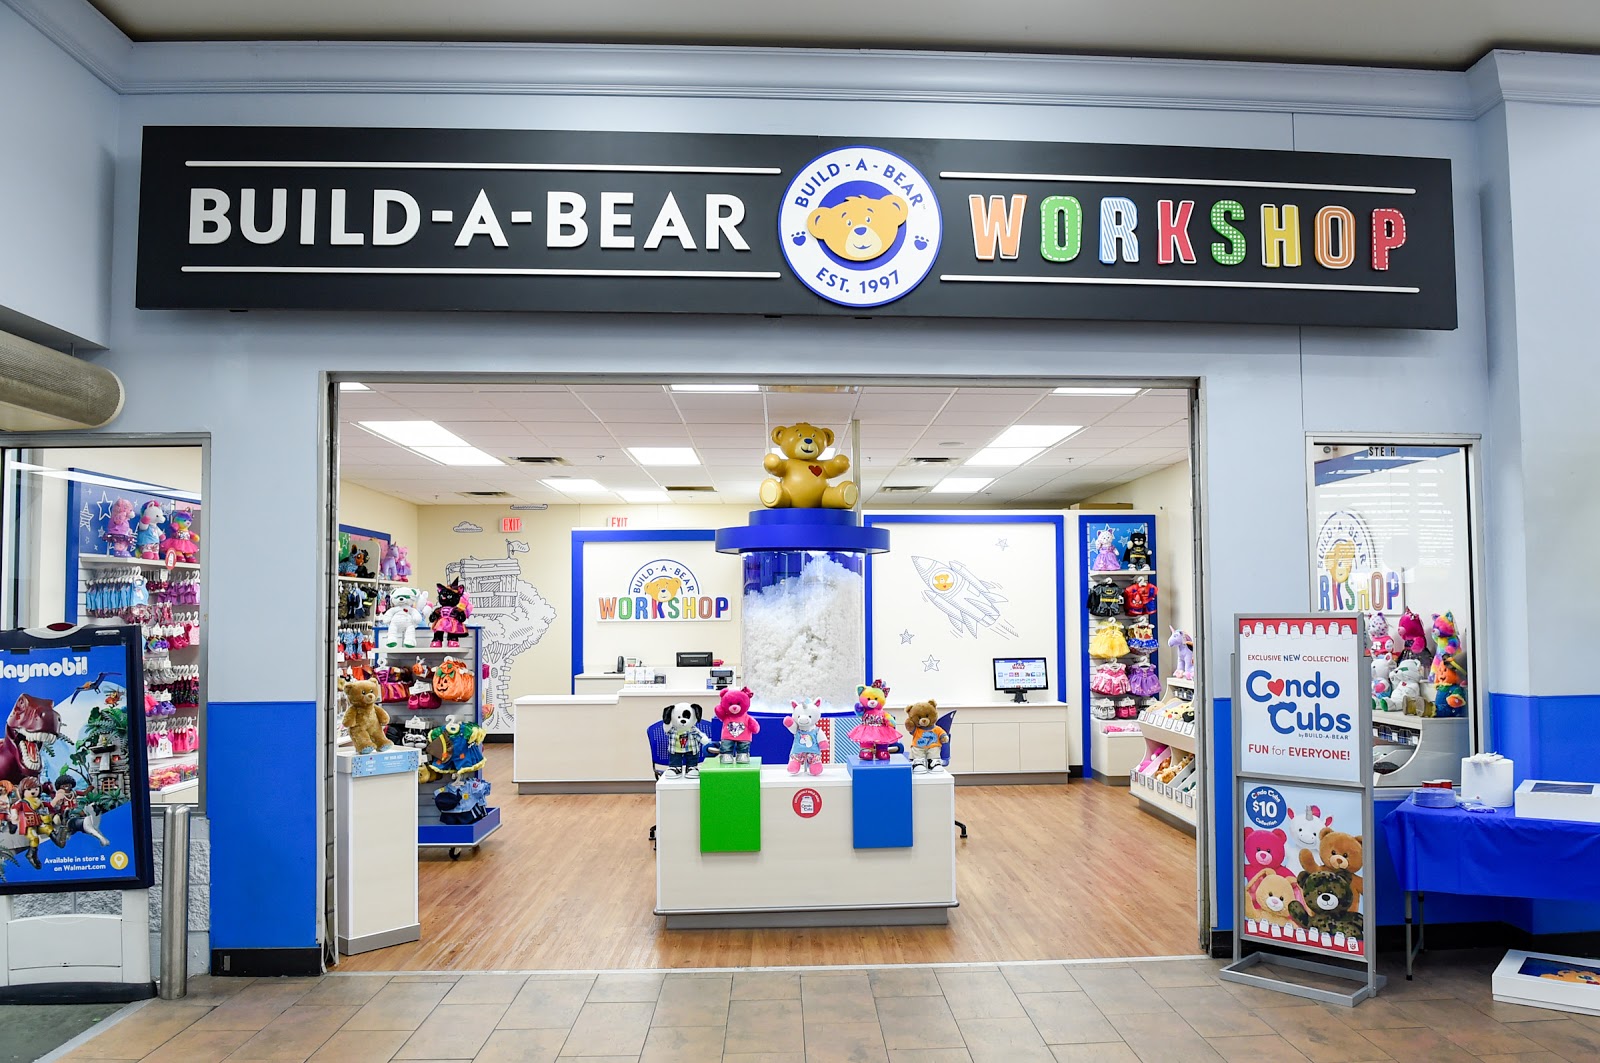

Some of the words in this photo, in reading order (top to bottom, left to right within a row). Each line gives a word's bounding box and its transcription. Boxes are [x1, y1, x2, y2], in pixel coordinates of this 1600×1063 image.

[188, 187, 751, 251] BUILD-A-BEAR
[968, 193, 1407, 270] WORKSHOP
[815, 266, 850, 293] EST.
[859, 269, 899, 294] 1997
[1368, 446, 1385, 457] STE
[1390, 446, 1396, 457] H
[503, 518, 520, 531] EXIT
[611, 517, 628, 527] EXIT
[1319, 571, 1400, 612] RKSHOP
[599, 596, 729, 620] WORKSHOP
[1283, 654, 1300, 662] NEW
[1302, 655, 1349, 663] COLLECTION!
[0, 656, 88, 683] laymobil
[1267, 701, 1352, 735] Cubs
[1304, 732, 1349, 741] BUILD-A-BEAR
[1248, 743, 1269, 755] FUN
[1272, 746, 1286, 756] for
[1288, 746, 1351, 761] EVERYONE!
[1252, 800, 1278, 818] $10
[44, 856, 74, 864] Available
[63, 863, 107, 871] Walmart.com
